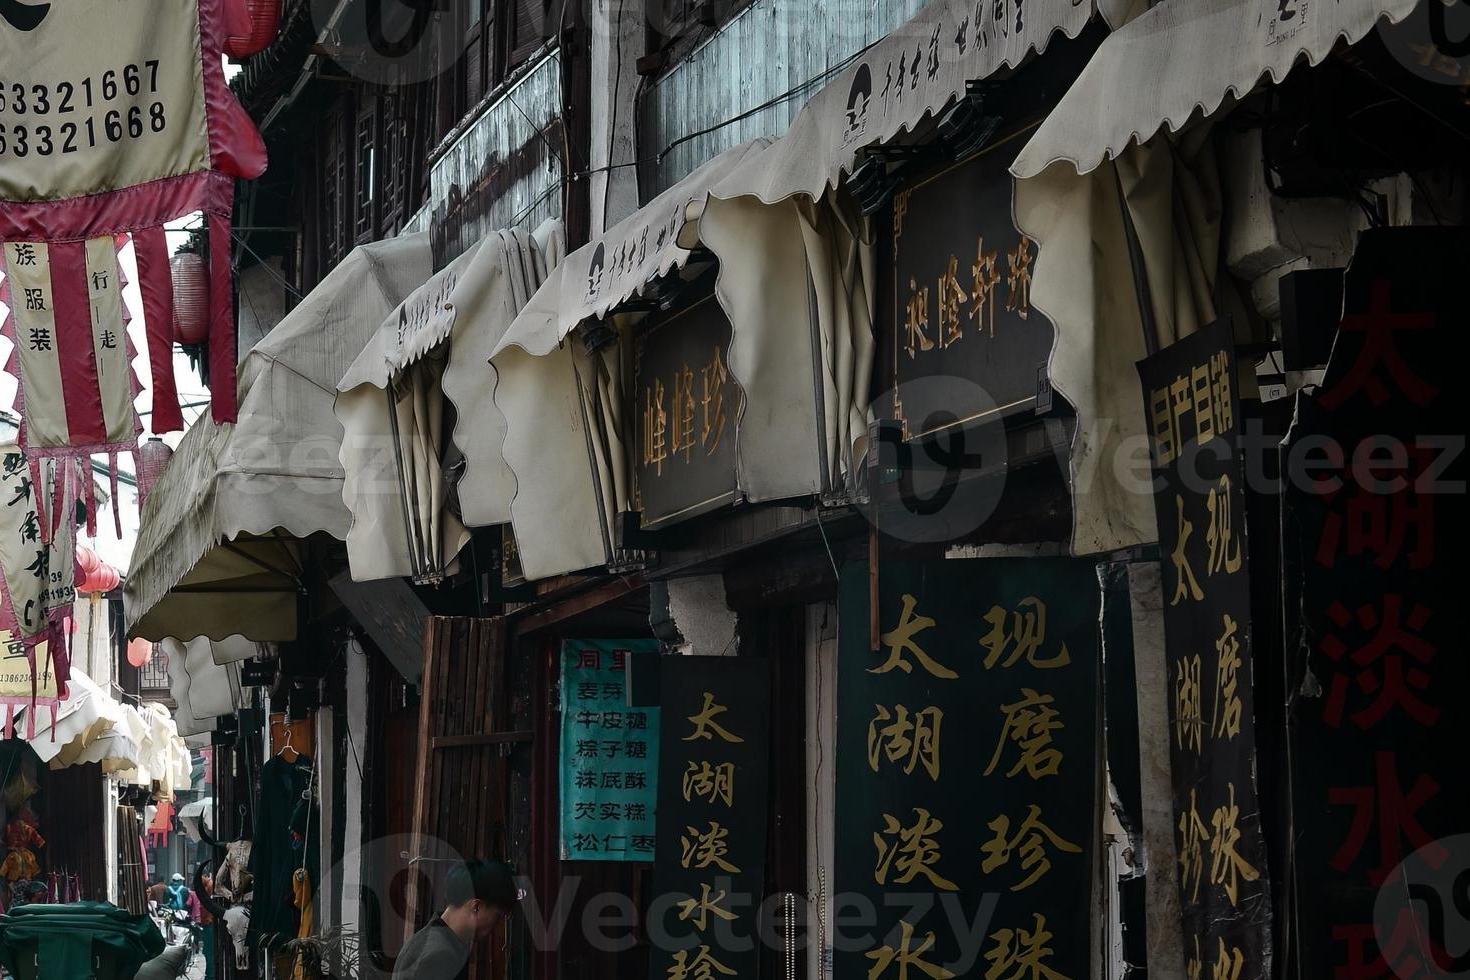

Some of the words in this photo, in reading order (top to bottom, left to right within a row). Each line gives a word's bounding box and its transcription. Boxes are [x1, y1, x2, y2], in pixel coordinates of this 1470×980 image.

[15, 244, 52, 351] 族服装
[643, 346, 743, 477] 峰峰珍
[576, 711, 647, 730] 牛皮糖
[576, 740, 647, 759] 粽子糖
[575, 772, 646, 790] 袜底酥
[574, 802, 646, 821] 芡实糕
